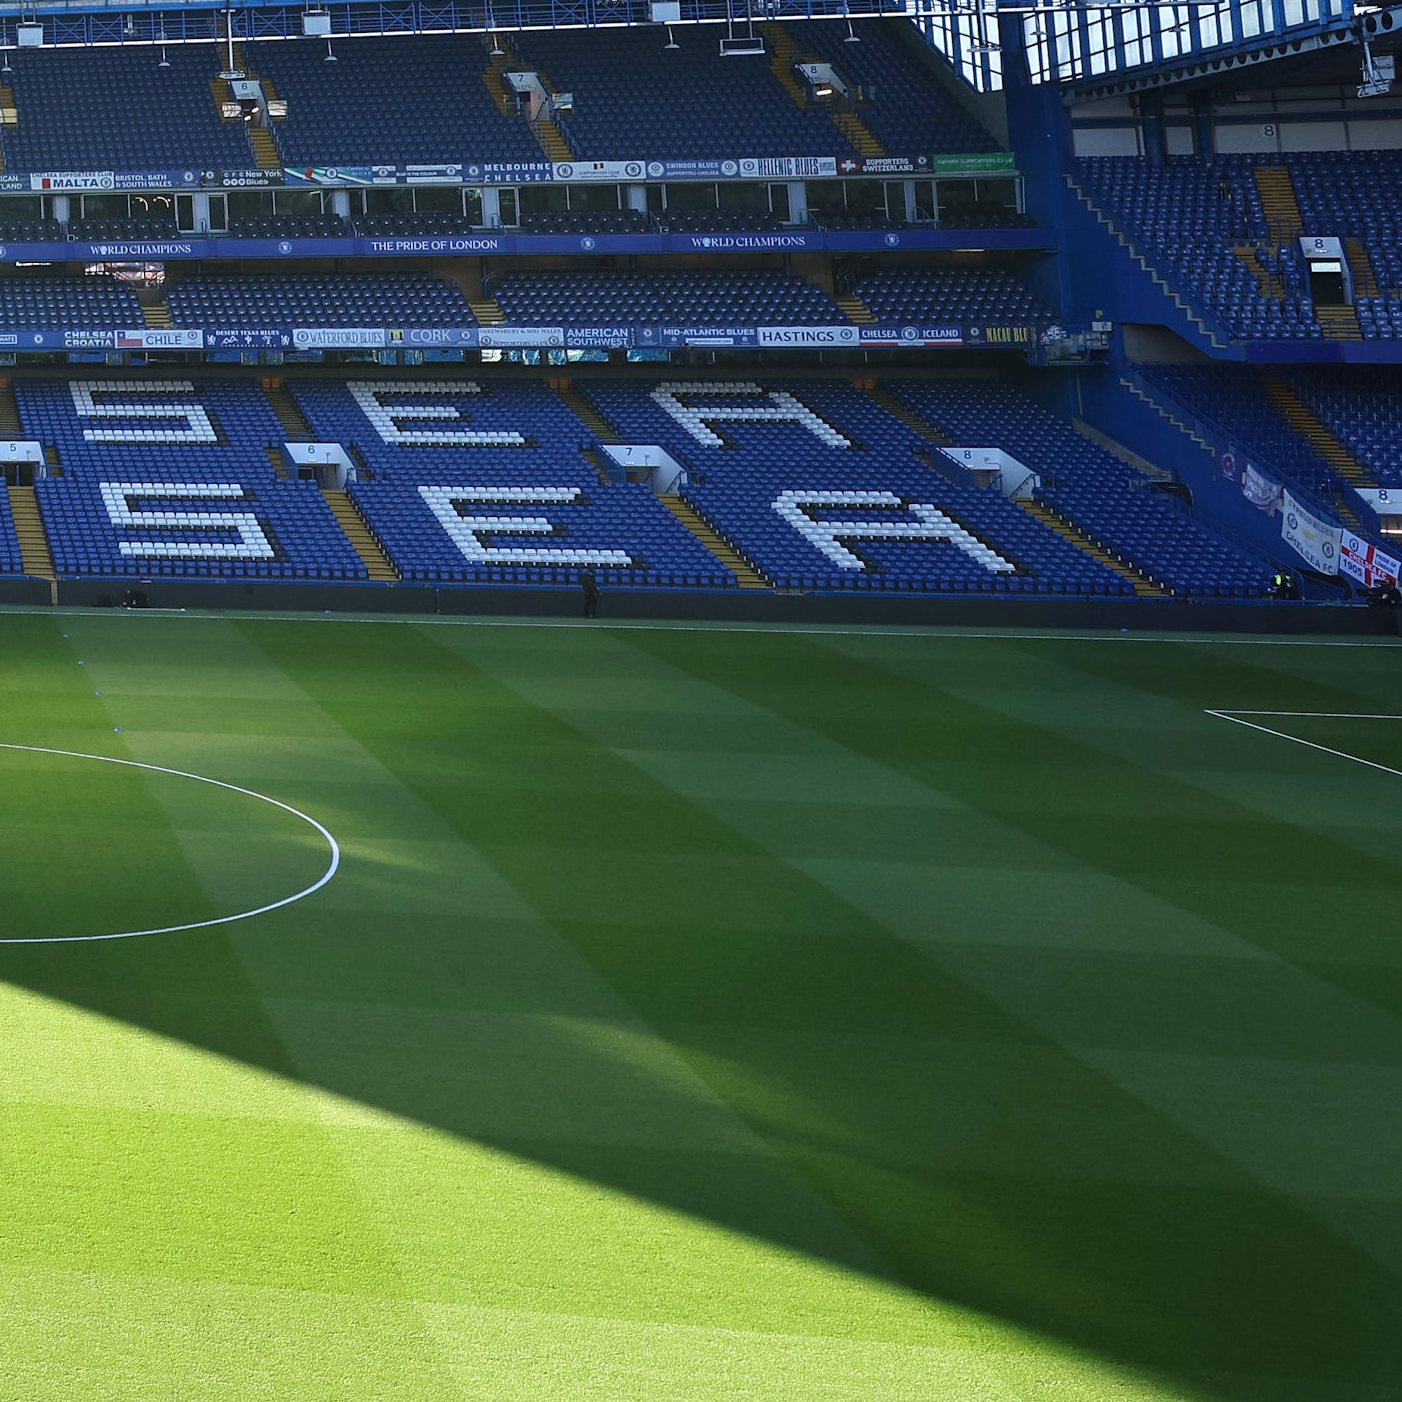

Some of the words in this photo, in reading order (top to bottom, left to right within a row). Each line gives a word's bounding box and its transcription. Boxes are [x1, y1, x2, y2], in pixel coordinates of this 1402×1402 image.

[810, 66, 817, 74] 8
[518, 74, 524, 82] 7
[241, 82, 248, 90] 6
[1264, 125, 1274, 137] 8
[484, 162, 551, 172] MELBOURNE
[758, 158, 792, 176] HELLENIC
[795, 158, 819, 175] BLUES
[484, 173, 552, 182] CHELSEA
[53, 178, 99, 188] MALTA
[371, 240, 394, 251] THE
[395, 240, 428, 251] PRIDE
[430, 240, 446, 251] OF
[449, 239, 497, 250] LONDON
[690, 237, 734, 248] WORLD
[736, 235, 806, 248] CHAMPIONS
[1314, 238, 1323, 248] 8
[90, 244, 130, 256] WORLD
[132, 244, 191, 254] CHAMPIONS
[65, 331, 113, 339] CHELSEA
[310, 330, 358, 344] WATERFORD
[360, 330, 382, 343] BLUES
[410, 330, 451, 342] CORK
[567, 328, 629, 338] AMERICAN
[762, 331, 834, 342] HASTINGS
[862, 330, 898, 338] CHELSEA
[923, 329, 959, 337] ICELAND
[146, 335, 182, 346] CHILE
[567, 337, 629, 346] SOUTHWEST
[10, 443, 16, 452] 5
[308, 445, 315, 454] 6
[625, 447, 632, 456] 7
[964, 450, 971, 459] 8
[1378, 490, 1388, 500] 8
[1286, 530, 1322, 571] CHELSEA
[1322, 563, 1334, 575] FC
[1343, 558, 1363, 578] 1905
[1348, 551, 1376, 575] CHELSEA
[1374, 568, 1387, 580] FC
